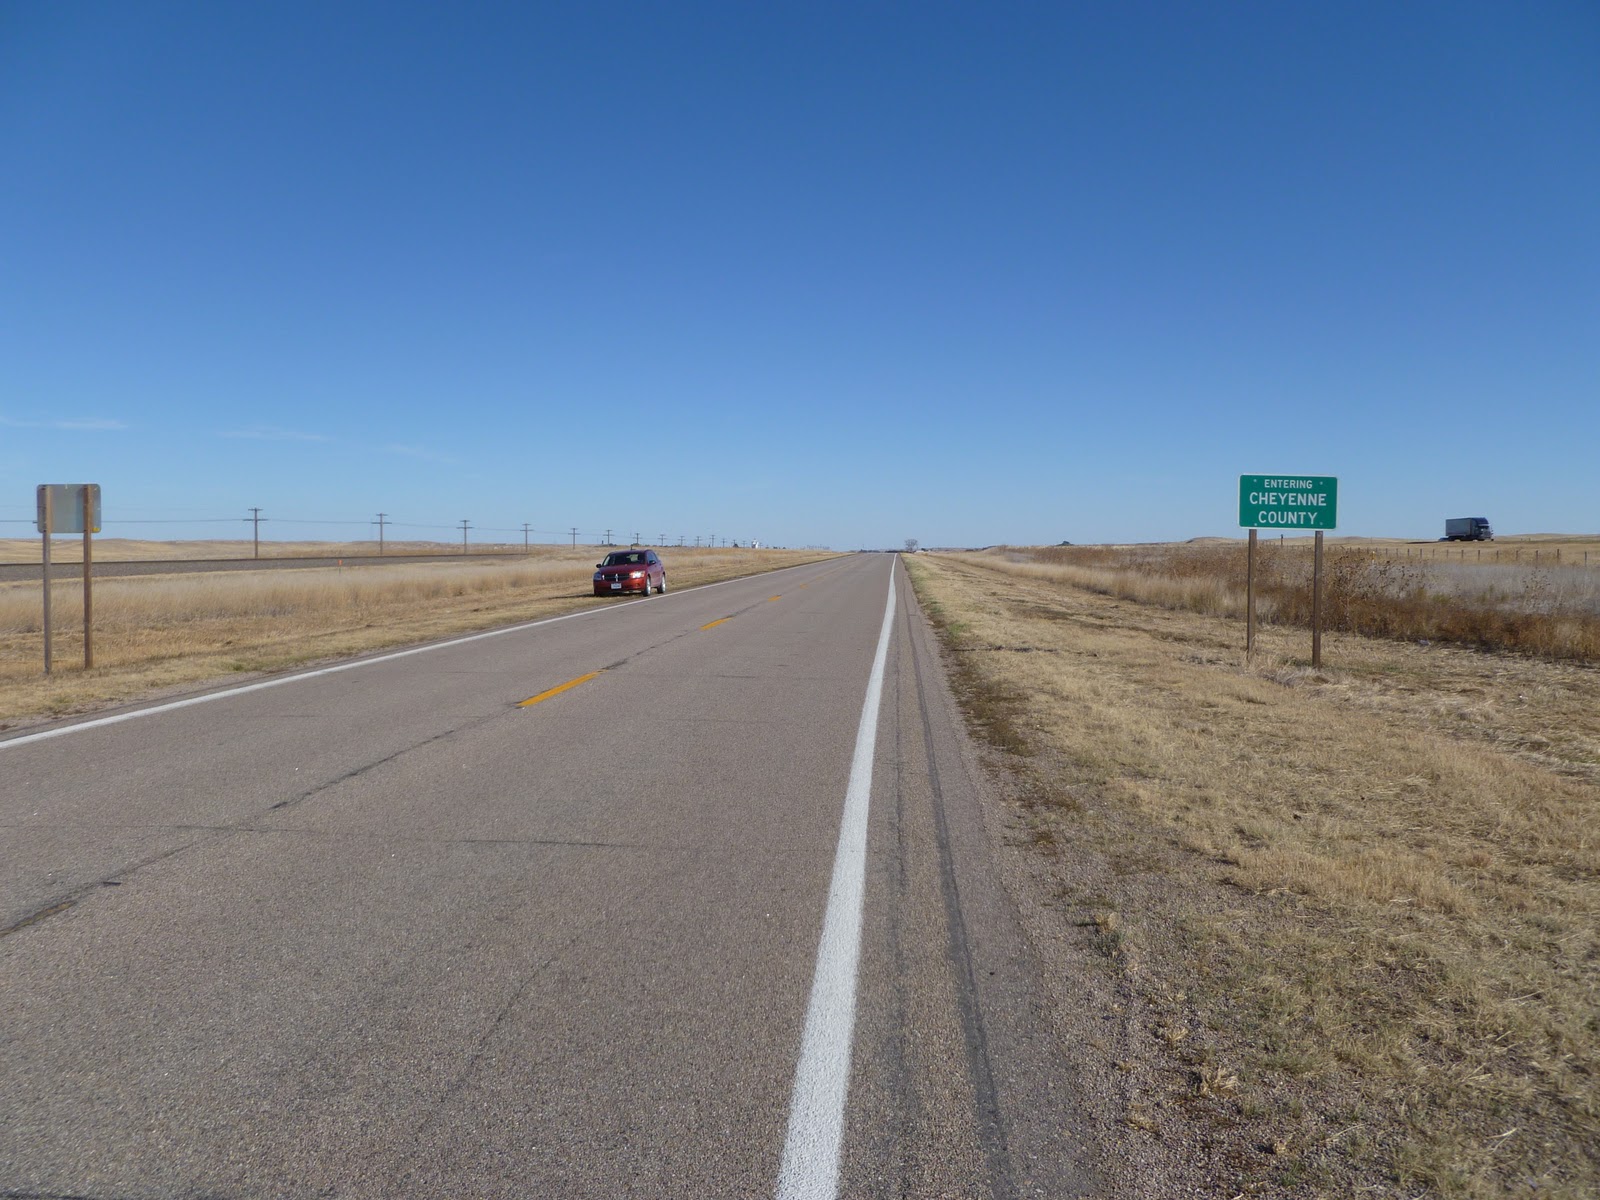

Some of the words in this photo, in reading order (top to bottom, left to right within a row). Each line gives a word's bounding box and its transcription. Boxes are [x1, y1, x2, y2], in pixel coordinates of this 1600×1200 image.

[1264, 479, 1313, 489] ENTERING
[1249, 492, 1327, 506] CHEYENNE
[1258, 510, 1318, 525] COUNTY
